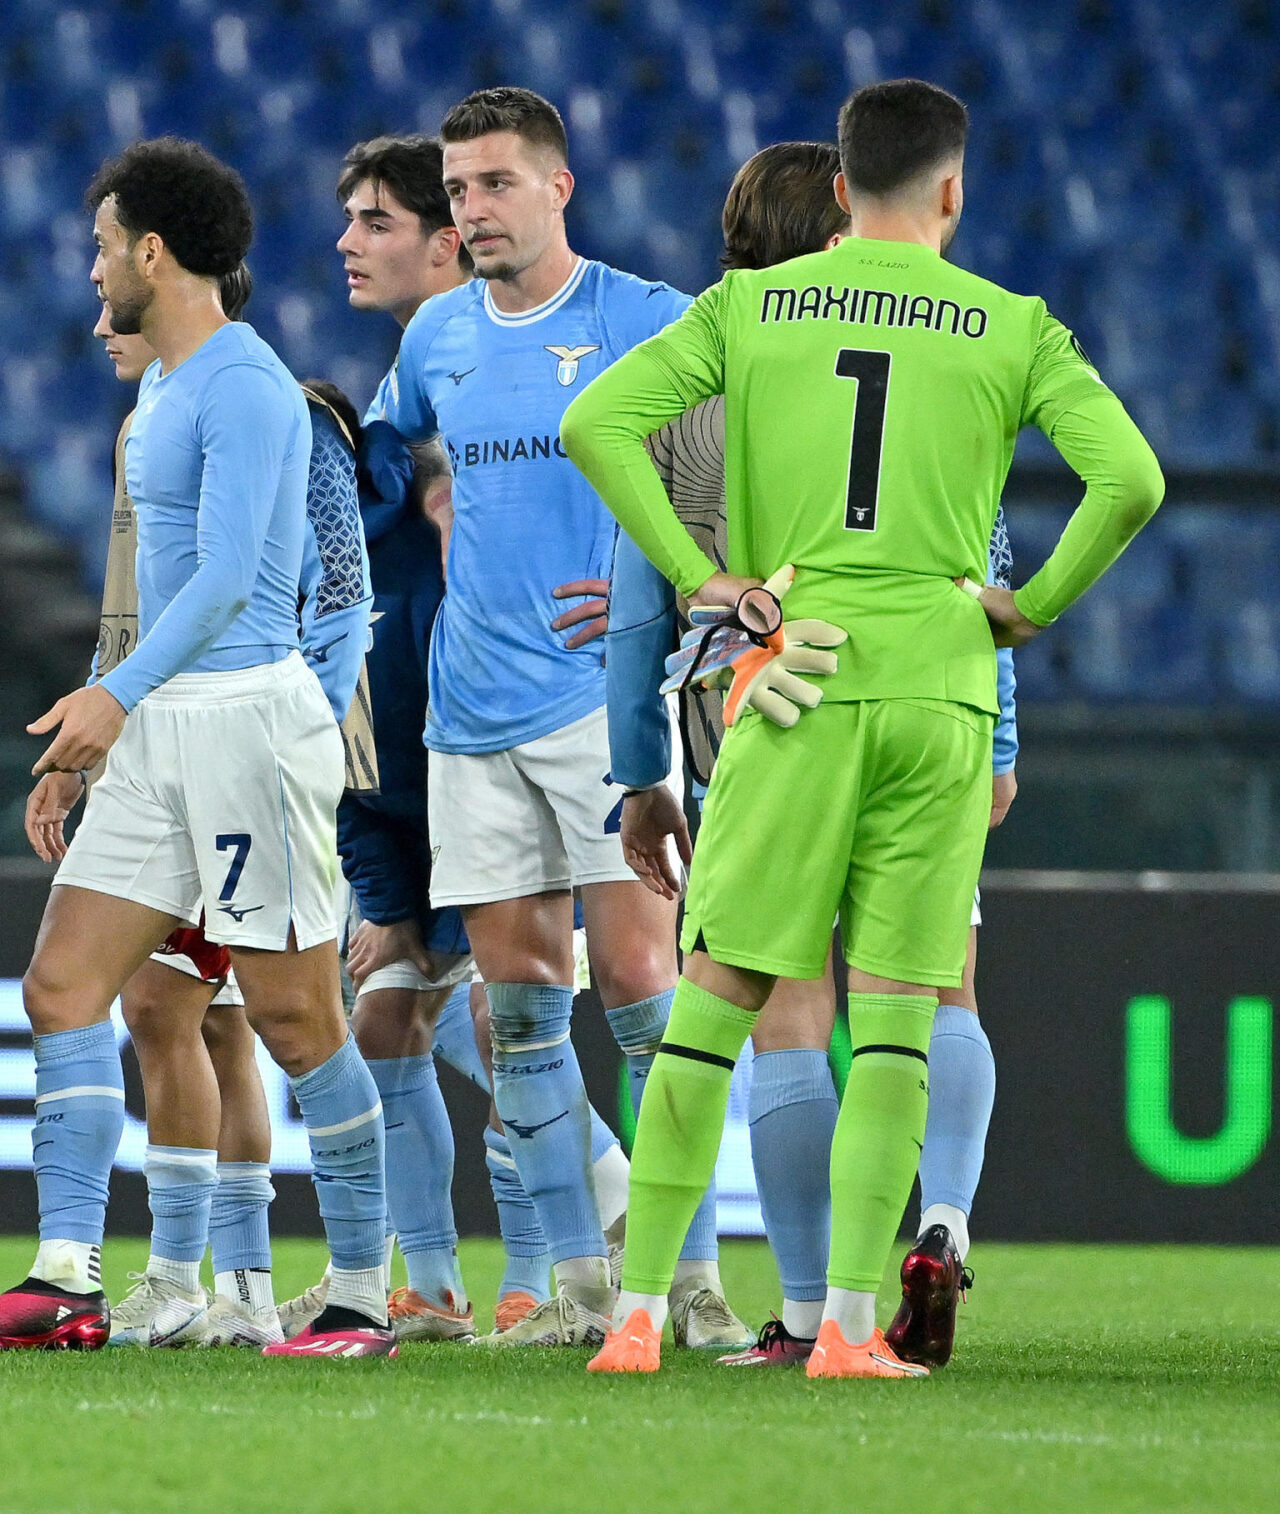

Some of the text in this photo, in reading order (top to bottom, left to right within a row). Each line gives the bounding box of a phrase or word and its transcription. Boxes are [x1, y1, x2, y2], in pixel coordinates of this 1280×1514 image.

[877, 260, 910, 270] LAZIO
[760, 285, 989, 339] MAXIMIANO
[464, 435, 569, 467] BINANC
[834, 347, 893, 532] 1
[215, 833, 252, 901] 7
[234, 1268, 251, 1304] DESIGN
